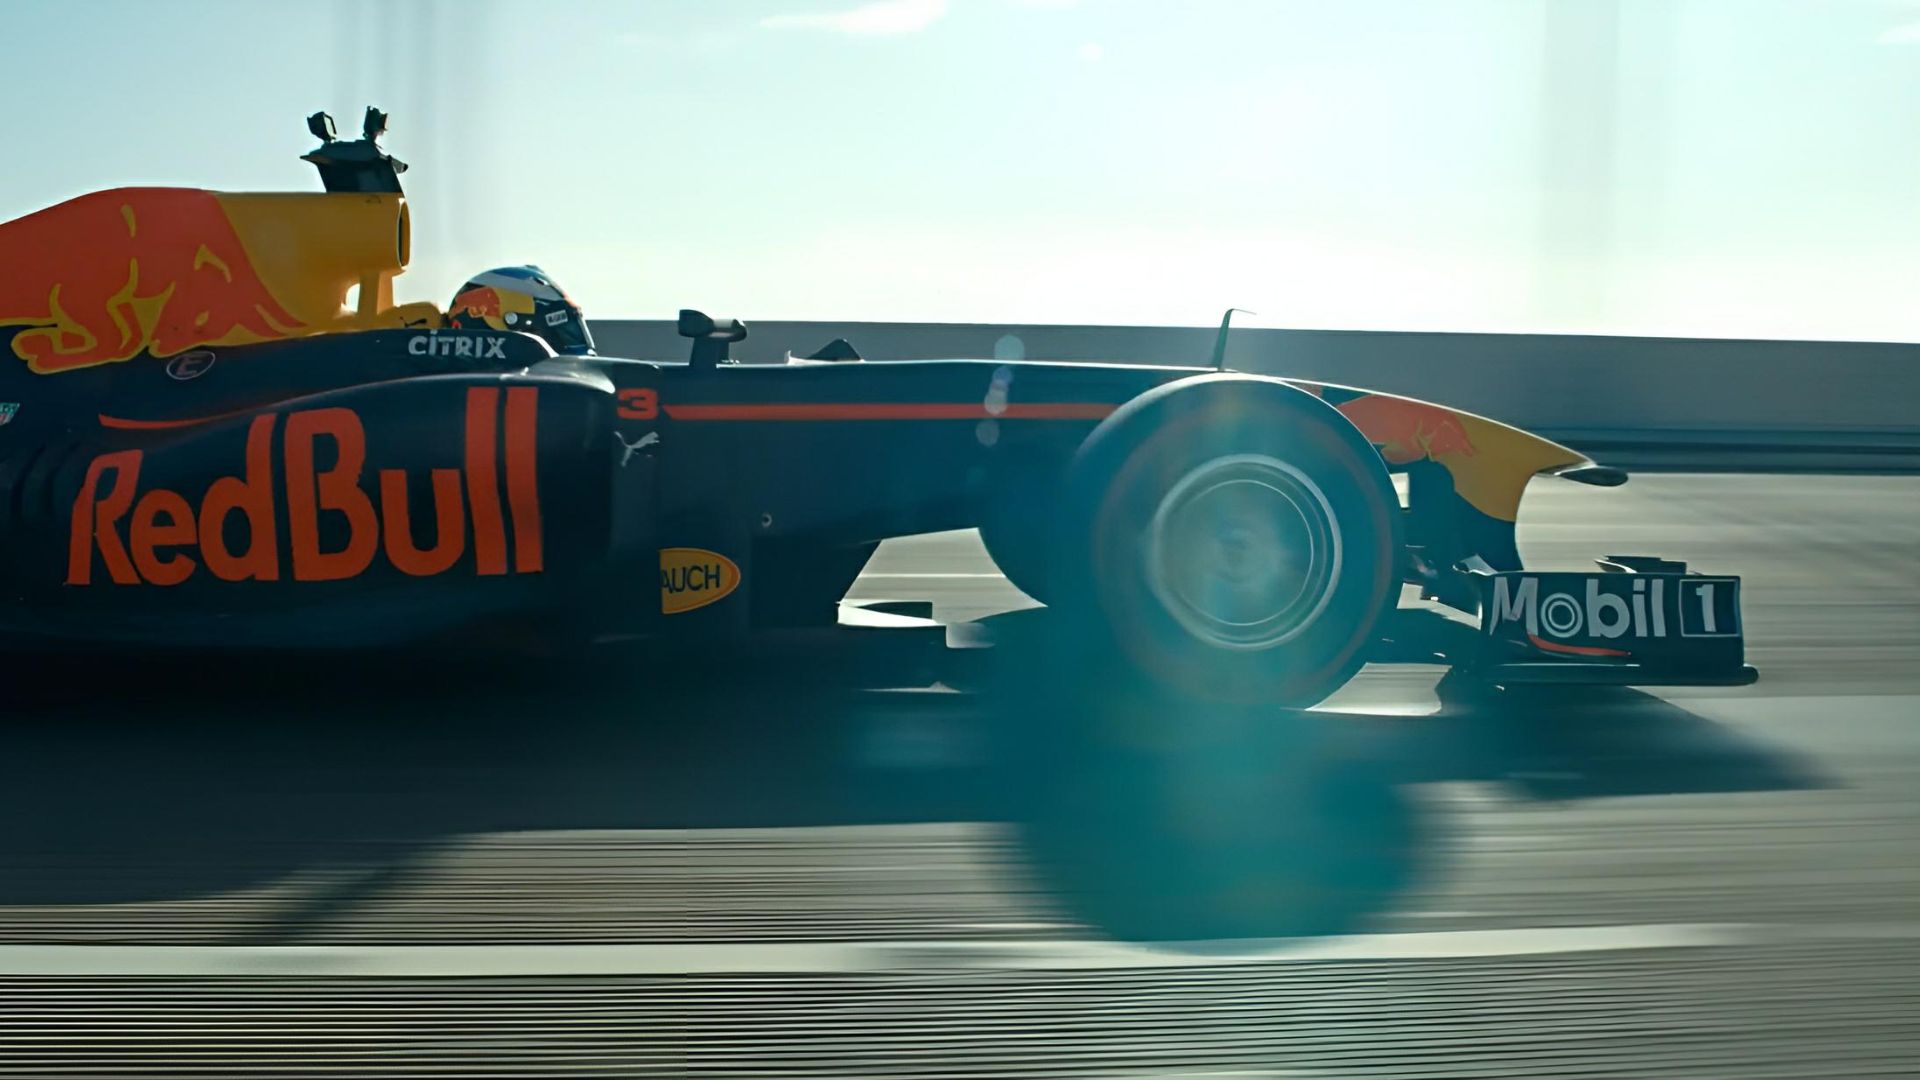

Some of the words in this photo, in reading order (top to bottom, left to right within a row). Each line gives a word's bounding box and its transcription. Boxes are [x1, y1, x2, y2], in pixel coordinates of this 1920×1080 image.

[617, 388, 658, 419] 3
[1489, 576, 1666, 638] Mobil
[1696, 583, 1717, 632] 1
